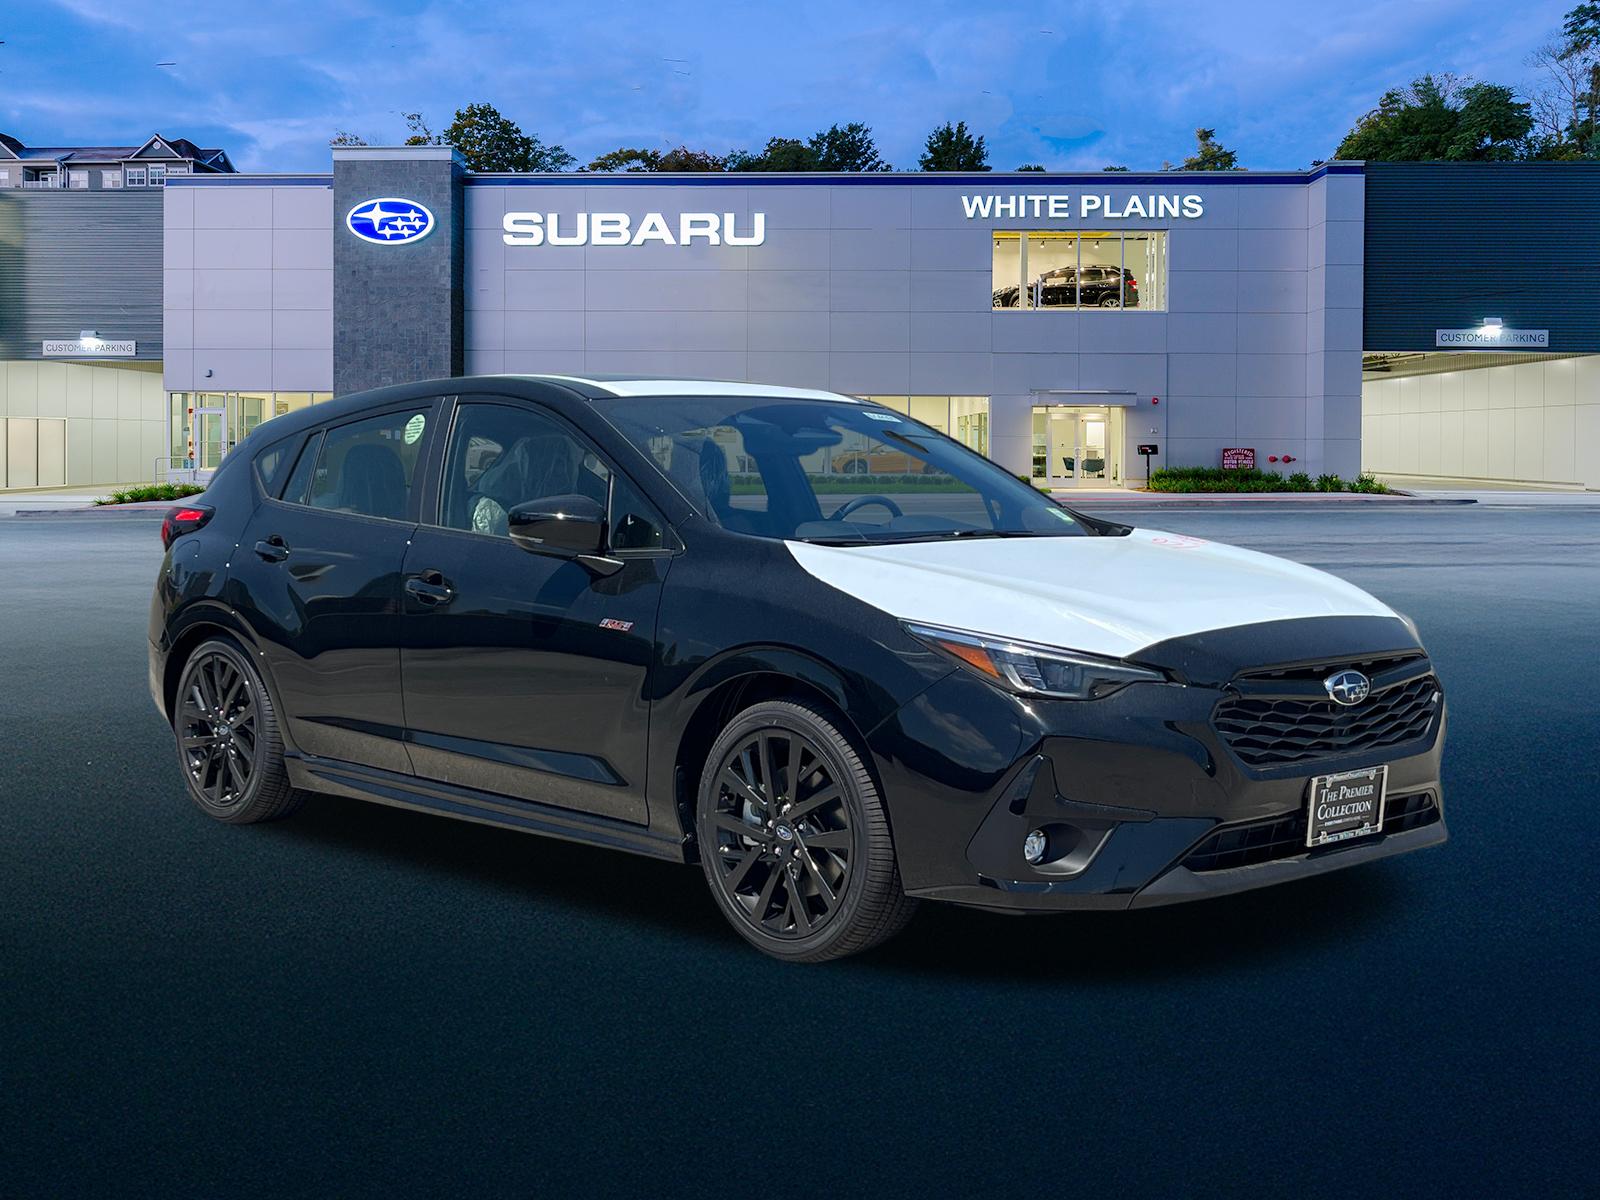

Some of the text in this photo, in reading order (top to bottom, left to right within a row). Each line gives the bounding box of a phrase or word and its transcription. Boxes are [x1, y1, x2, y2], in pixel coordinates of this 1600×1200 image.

[961, 195, 1204, 218] WHITE PLAINS
[503, 212, 765, 246] SUBARU
[45, 343, 133, 352] CUSTOMER PARKING
[1440, 333, 1545, 343] CUSTOMER PARKING
[1320, 785, 1374, 803] THE PREMIER
[1317, 800, 1372, 820] COLLECTION
